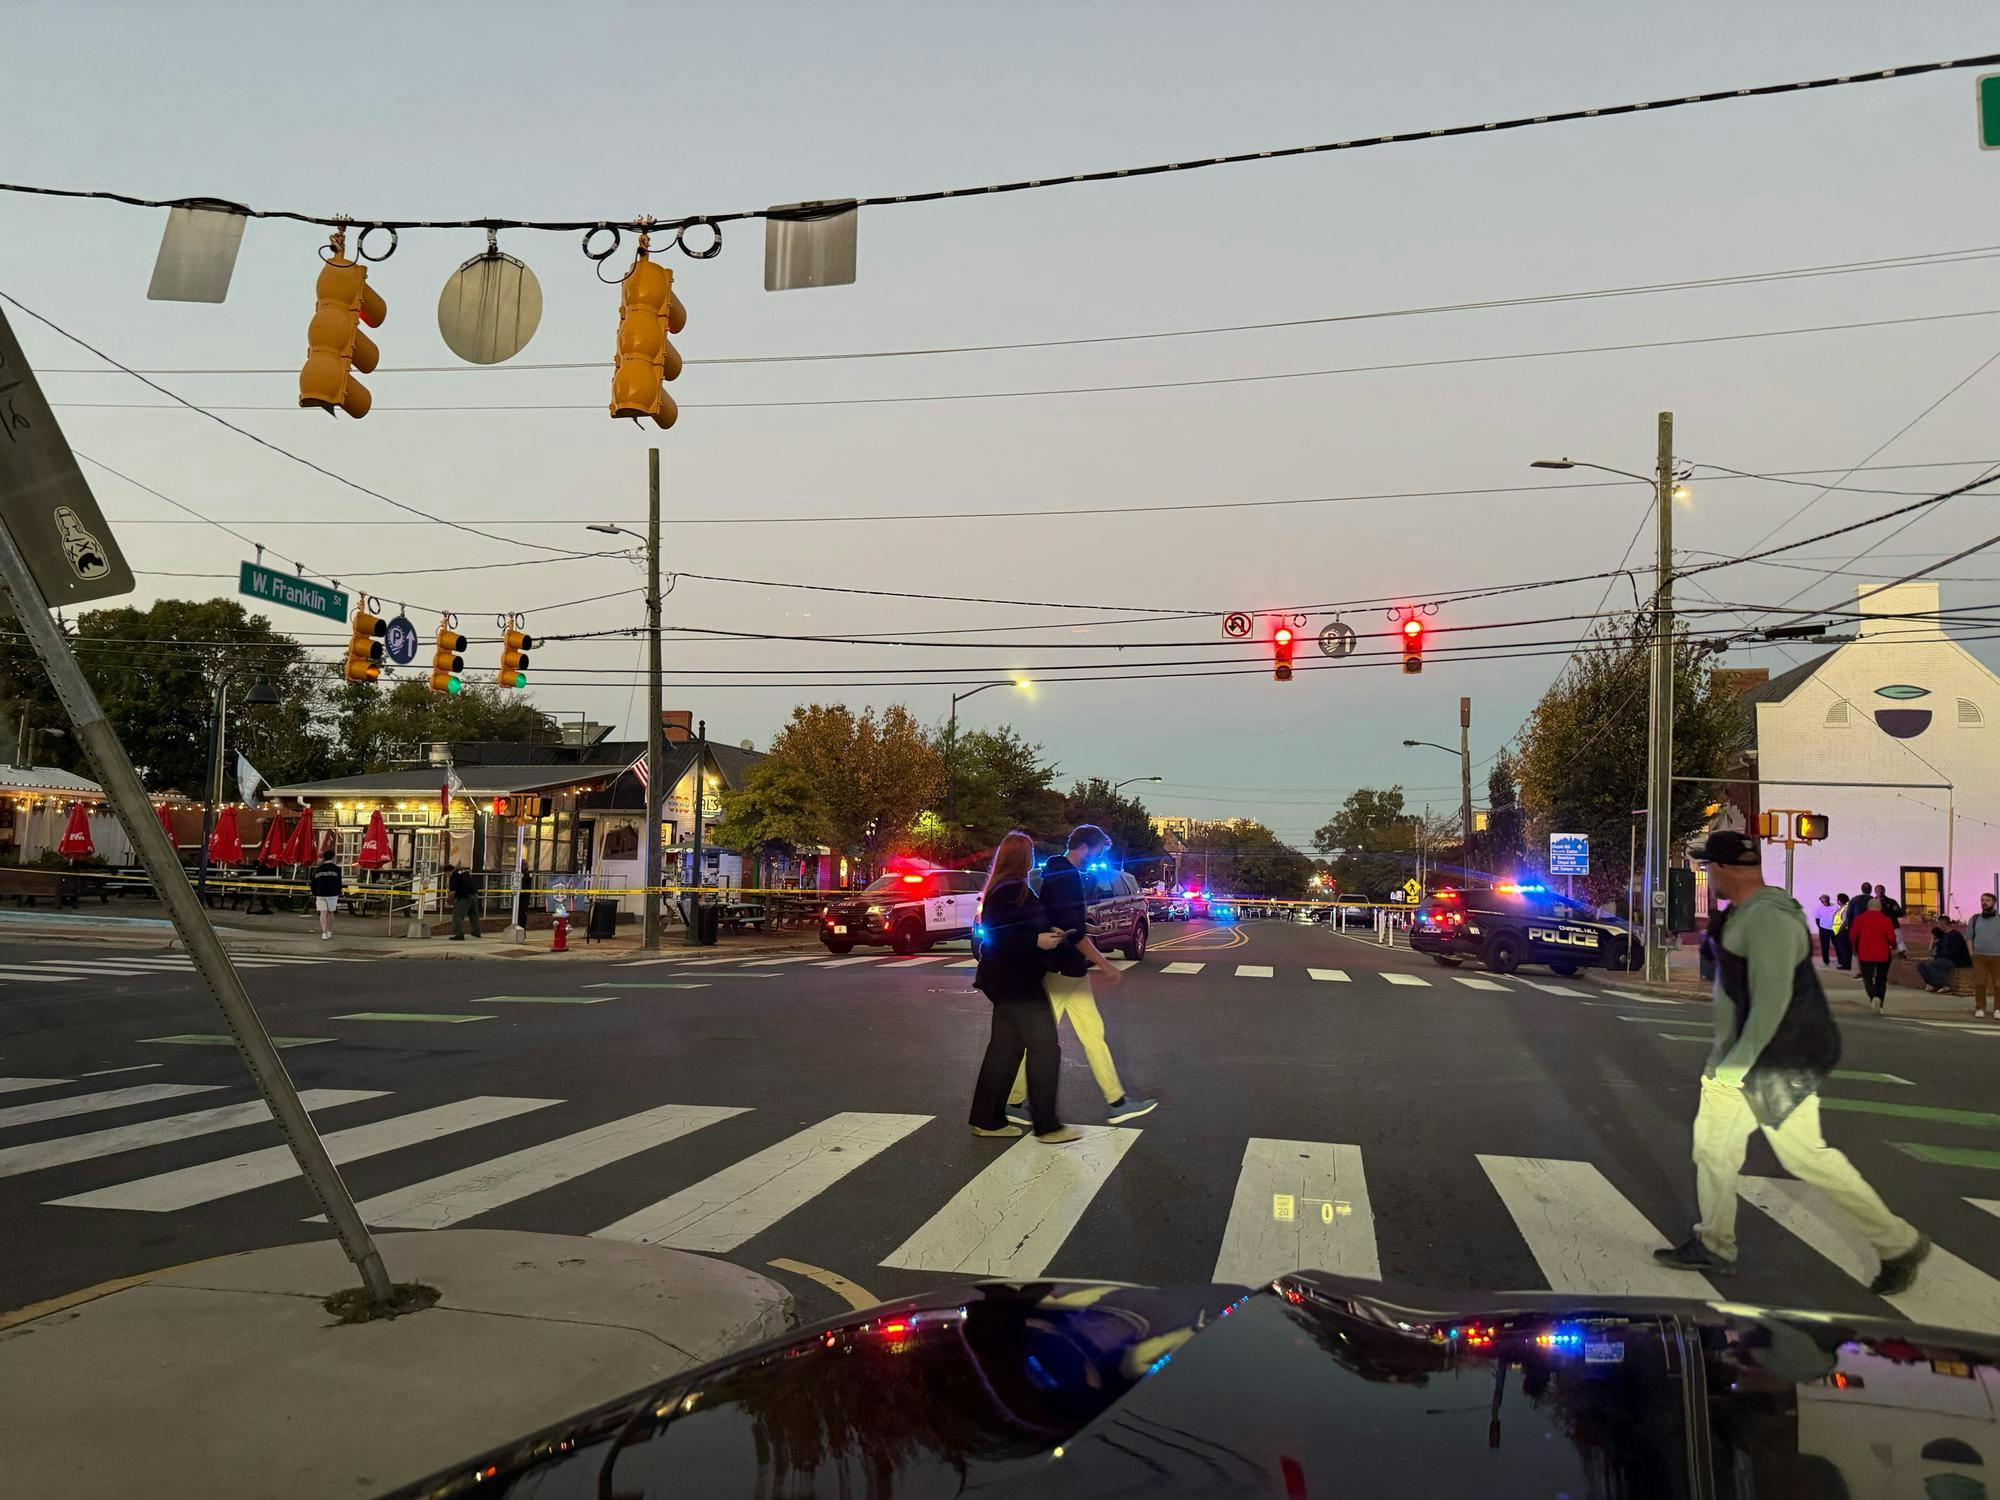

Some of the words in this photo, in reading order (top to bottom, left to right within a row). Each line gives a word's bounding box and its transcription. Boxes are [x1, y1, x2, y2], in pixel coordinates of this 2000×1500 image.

[252, 571, 268, 594] W.
[271, 577, 326, 611] Franklin
[332, 594, 342, 606] St
[1528, 927, 1599, 948] POLICE
[1558, 925, 1584, 933] CHAPEL
[1278, 1207, 1290, 1216] 20
[1322, 1203, 1334, 1224] 0
[1336, 1205, 1352, 1215] mph
